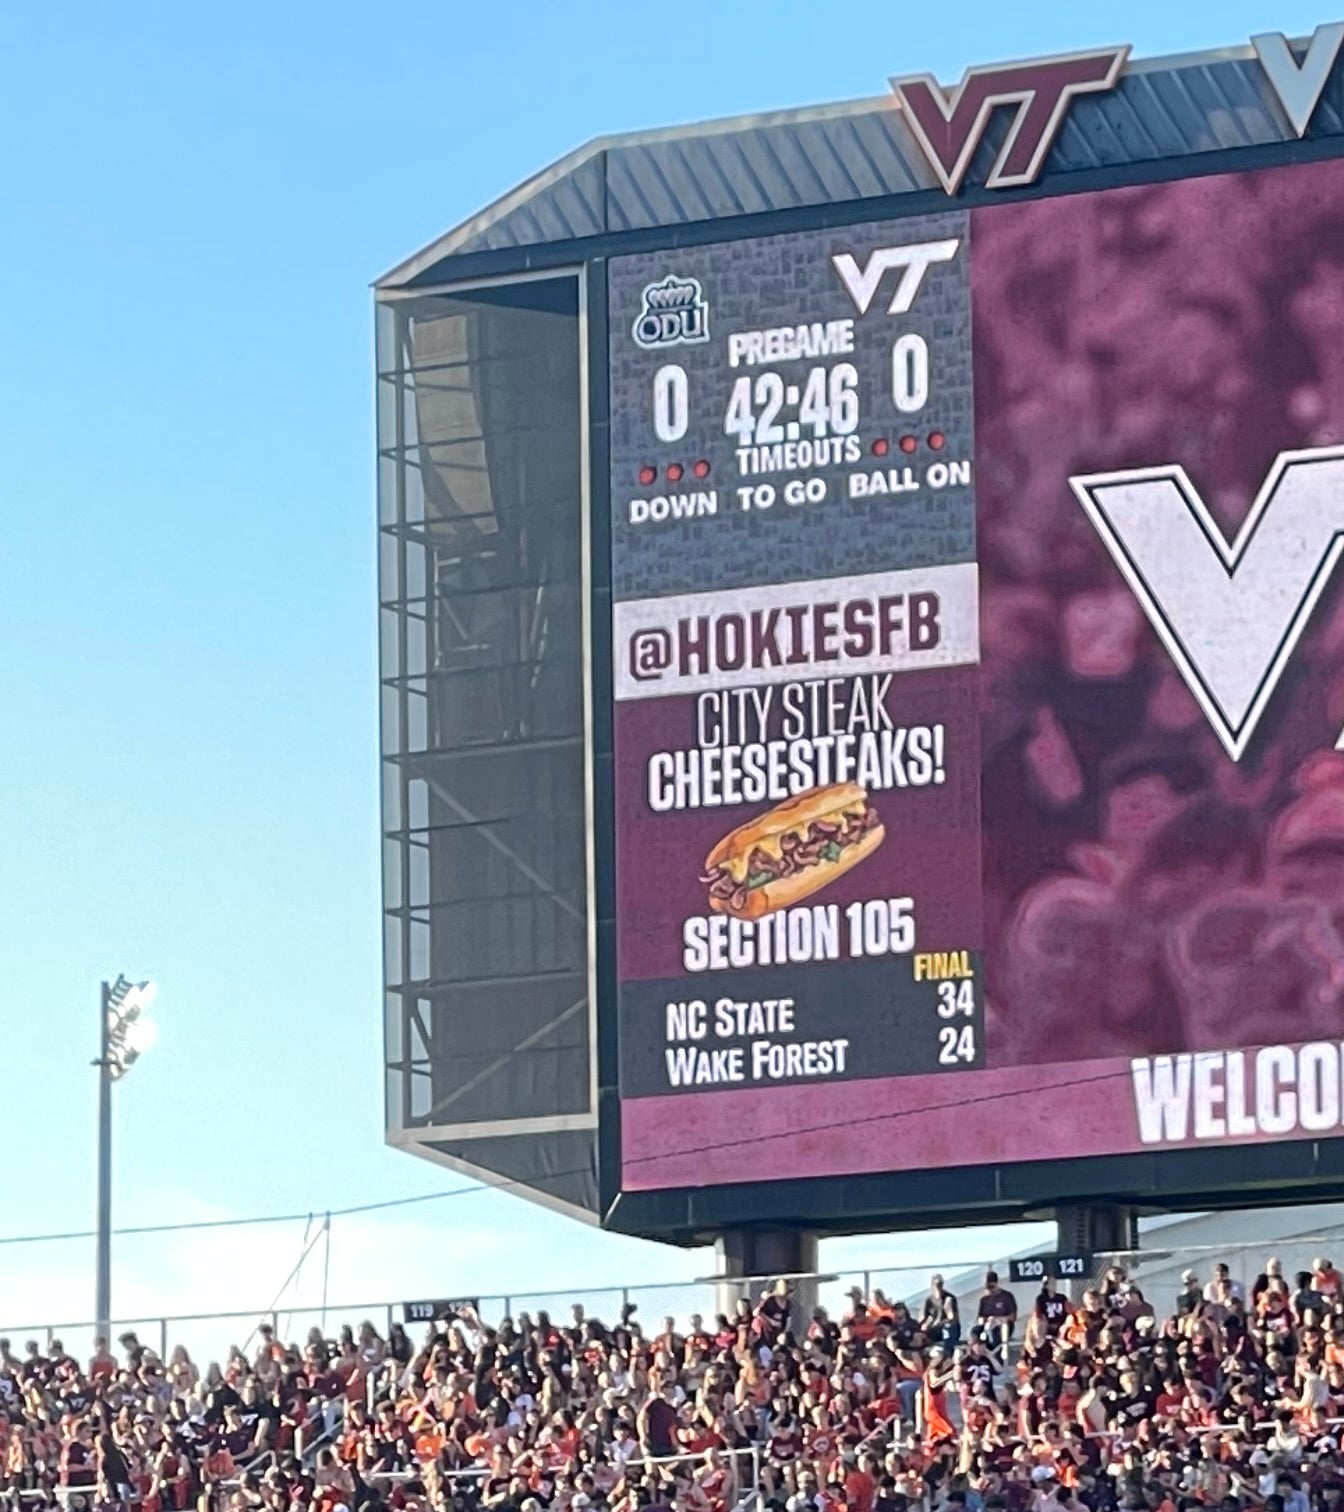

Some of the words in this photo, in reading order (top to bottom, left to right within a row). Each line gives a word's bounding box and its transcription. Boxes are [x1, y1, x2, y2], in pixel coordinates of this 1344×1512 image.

[887, 43, 1133, 196] VT
[832, 239, 958, 315] VT
[634, 302, 709, 347] ODU
[729, 320, 855, 367] PREGAME
[891, 333, 929, 413] 0
[653, 364, 689, 442] 0
[724, 363, 859, 446] 42:46
[736, 434, 861, 476] TIMEOUTS
[737, 483, 776, 510] TO
[783, 478, 827, 506] GO
[849, 467, 919, 499] BALL
[926, 461, 971, 488] ON
[629, 490, 718, 524] DOWN
[629, 590, 943, 680] @HOKIESFB
[697, 686, 773, 752] CITY
[782, 673, 895, 740] STEAK
[646, 724, 947, 812] CHEESESTEAKS!
[683, 903, 841, 973] SECTION
[846, 898, 916, 956] 105
[913, 951, 974, 981] FINAL
[666, 1000, 708, 1041] NC
[715, 997, 795, 1036] STATE
[937, 980, 974, 1019] 34
[938, 1026, 975, 1065] 24
[1017, 1260, 1044, 1276] 120
[1059, 1258, 1084, 1274] 121
[410, 1304, 435, 1317] 119
